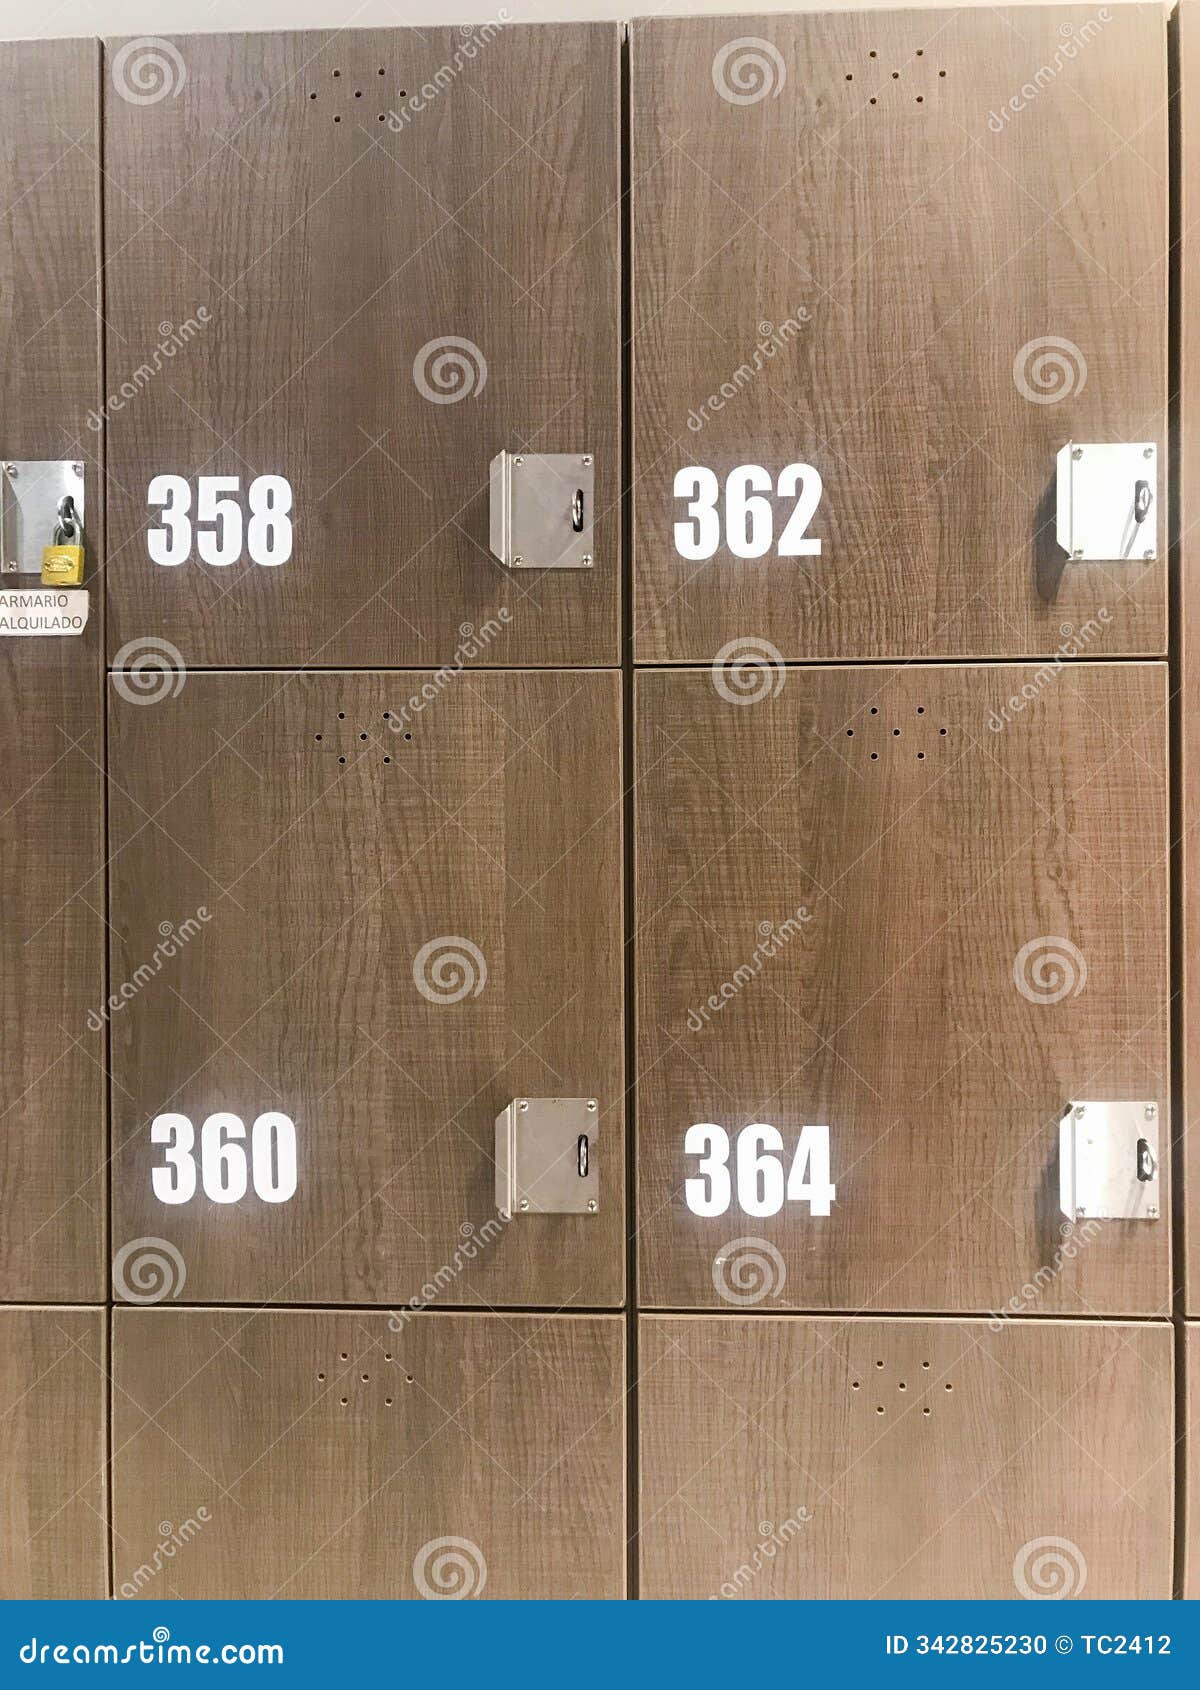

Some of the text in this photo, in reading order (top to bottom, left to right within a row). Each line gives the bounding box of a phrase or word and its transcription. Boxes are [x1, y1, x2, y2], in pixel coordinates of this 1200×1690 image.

[147, 474, 293, 567] 358
[673, 463, 822, 560] 362
[0, 595, 68, 608] ARMARIO
[0, 616, 83, 630] ALQUILADO
[151, 1111, 297, 1205] 360
[684, 1123, 836, 1218] 364
